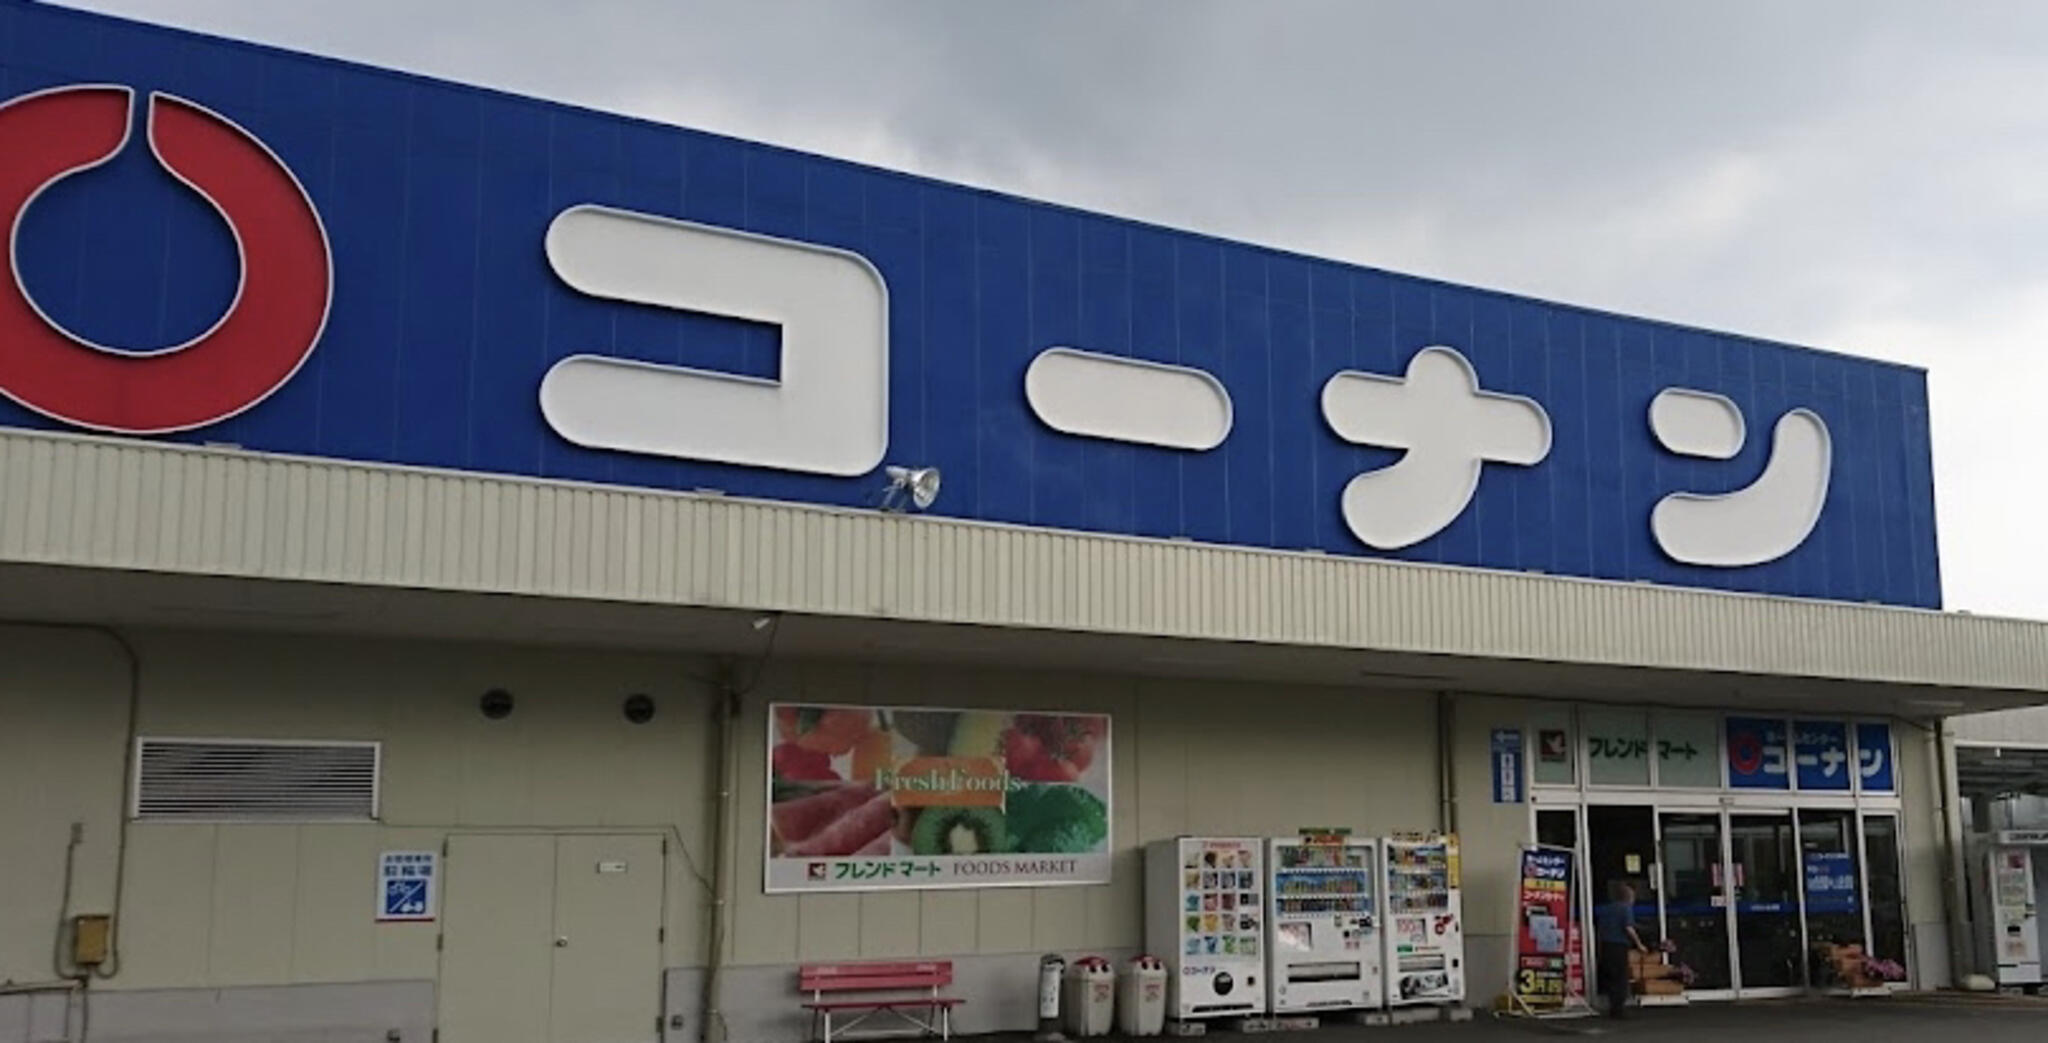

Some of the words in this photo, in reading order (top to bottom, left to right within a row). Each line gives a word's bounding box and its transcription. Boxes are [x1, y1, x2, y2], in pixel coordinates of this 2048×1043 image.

[540, 204, 1832, 567] コーナン
[1762, 746, 1883, 778] コーナン
[874, 768, 947, 792] Fresh
[951, 768, 1022, 792] Foods
[953, 861, 1010, 876] FOODS
[1014, 859, 1078, 875] MARKET
